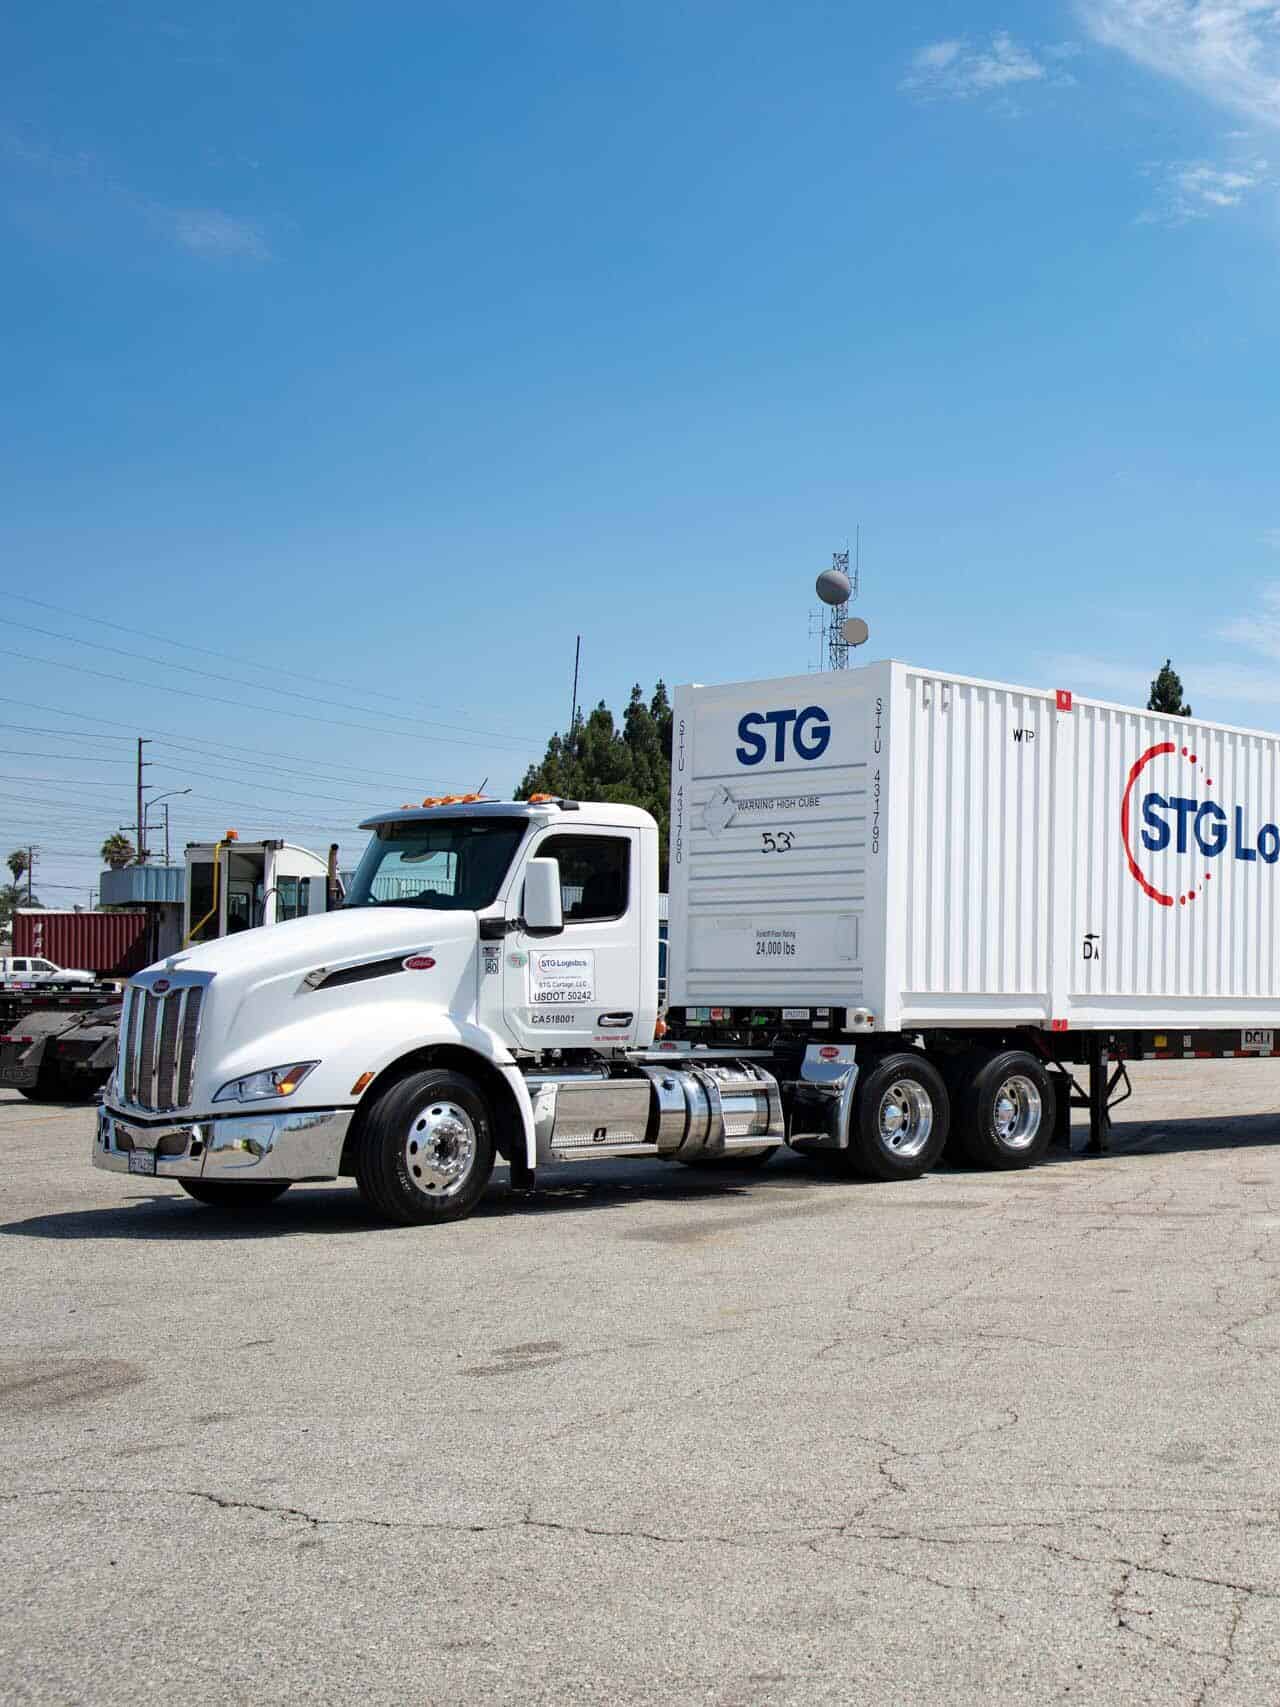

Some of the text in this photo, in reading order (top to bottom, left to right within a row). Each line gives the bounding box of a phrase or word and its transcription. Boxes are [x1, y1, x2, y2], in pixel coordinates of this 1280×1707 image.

[736, 706, 831, 766] STG
[737, 797, 821, 811] WARNING HIGH CUBE
[872, 769, 881, 854] 431790
[675, 785, 683, 864] 431790
[1141, 792, 1228, 857] STG
[756, 941, 796, 956] 24,000 lbs
[541, 960, 588, 968] STG Logistics
[534, 991, 565, 1001] USDOT
[531, 1015, 575, 1024] CA518001
